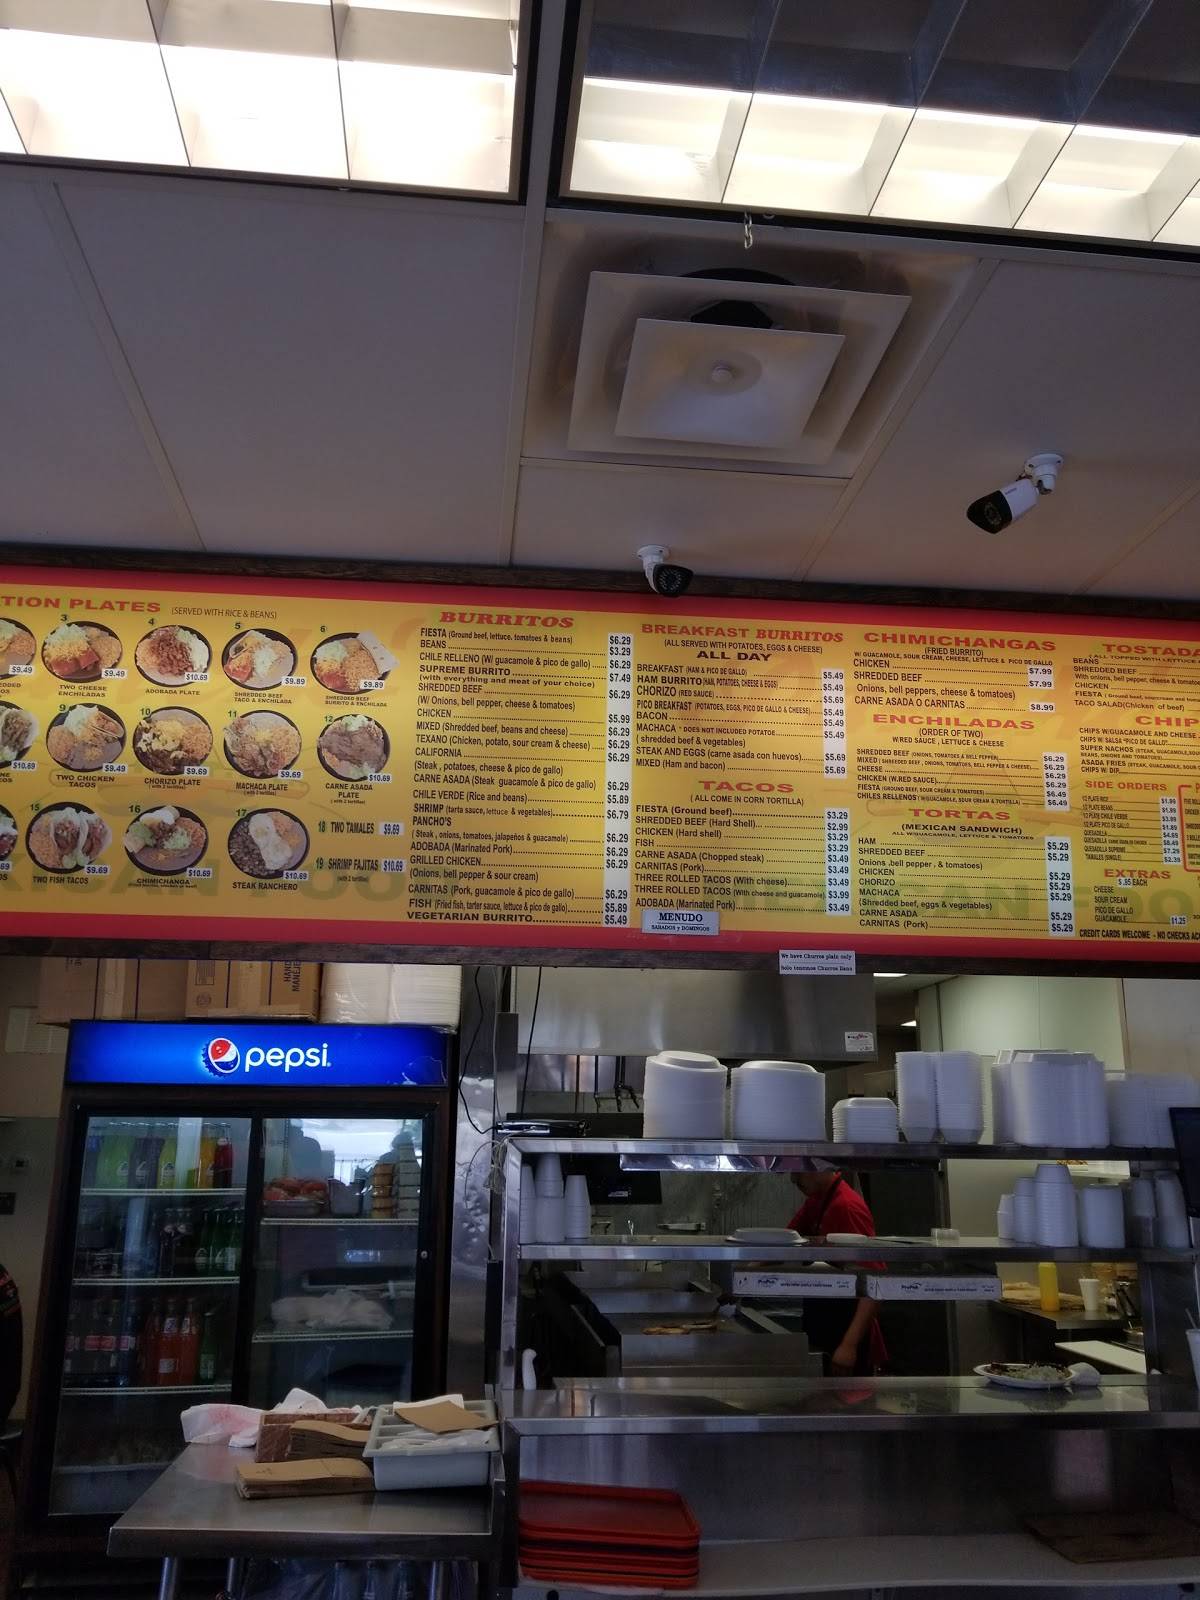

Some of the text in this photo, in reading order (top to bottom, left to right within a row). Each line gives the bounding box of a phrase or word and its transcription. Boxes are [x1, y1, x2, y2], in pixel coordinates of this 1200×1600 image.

[69, 599, 160, 612] PLATES
[172, 608, 199, 616] (SERVED
[204, 609, 223, 617] WITH
[225, 609, 241, 617] RICE
[250, 611, 277, 619] BEANS)
[234, 622, 241, 630] 5
[440, 611, 574, 628] BURRITOS
[420, 628, 447, 639] FIESTA
[448, 630, 473, 639] (Ground
[474, 633, 488, 641] beef,
[514, 634, 542, 642] tomatoes
[550, 636, 573, 644] beans)
[609, 637, 631, 645] $6.29
[641, 624, 844, 642] BREAKFAST BURRITOS
[420, 640, 631, 656] BEANS $3.29
[681, 640, 708, 648] SERVED
[729, 642, 765, 650] POTATOES,
[787, 644, 793, 652] &
[794, 645, 823, 654] CHEESE)
[864, 633, 1056, 651] CHIMICHANGAS
[697, 651, 772, 661] ALL DAY
[925, 647, 983, 657] (FRIED BURRITO)
[420, 652, 442, 661] CHILE
[444, 653, 479, 663] RELLENO
[495, 657, 534, 666] guacamole
[543, 659, 558, 668] pico
[571, 660, 591, 669] gallo)
[609, 660, 631, 669] $6.29
[853, 659, 890, 667] CHICKEN
[12, 666, 32, 674] $9.49
[419, 665, 631, 682] SUPREME BURRITO $7.49
[418, 683, 630, 699] SHREDDED BEEF $6.29
[637, 686, 844, 704] CHORIZO (RED SAUCE) $5.69
[417, 709, 630, 723] CHICKEN $5.99
[636, 712, 844, 727] BACON $5.49
[873, 714, 1034, 729] ENCHILADAS
[1136, 716, 1199, 726] CHIP
[919, 729, 949, 737] (ORDER
[964, 730, 983, 738] TWO)
[636, 759, 660, 768] MIXED
[662, 760, 682, 770] (Ham
[700, 761, 726, 771] bacon)
[825, 766, 845, 774] $5.69
[698, 781, 794, 793] TACOS
[1118, 782, 1167, 790] ORDERS
[412, 816, 452, 826] PANCHO'S
[909, 809, 1010, 820] TORTAS
[318, 821, 325, 832] 18
[331, 822, 345, 833] TWO
[347, 822, 374, 834] TAMALES
[901, 823, 1022, 834] (MEXICAN SANDWICH)
[635, 828, 848, 842] CHICKEN (Hard shell) $3.29
[410, 842, 628, 856] ADOBADA (Marinated Pork) $6.29
[858, 837, 1069, 850] HAM $5.29
[316, 858, 324, 869] 19
[328, 858, 352, 870] SHRIMP
[354, 859, 378, 871] FAJITAS
[1104, 869, 1171, 879] EXTRAS
[258, 883, 297, 891] RANCHERO
[859, 878, 895, 886] CHORIZO
[407, 911, 627, 925] VEGETARIAN BURRITO $5.49
[659, 913, 703, 922] MENUDO
[859, 919, 1073, 932] CARNITAS (Pork) $5.29
[1080, 929, 1102, 937] CREDIT
[1122, 930, 1150, 938] WELCOME
[245, 1043, 328, 1072] pepsi
